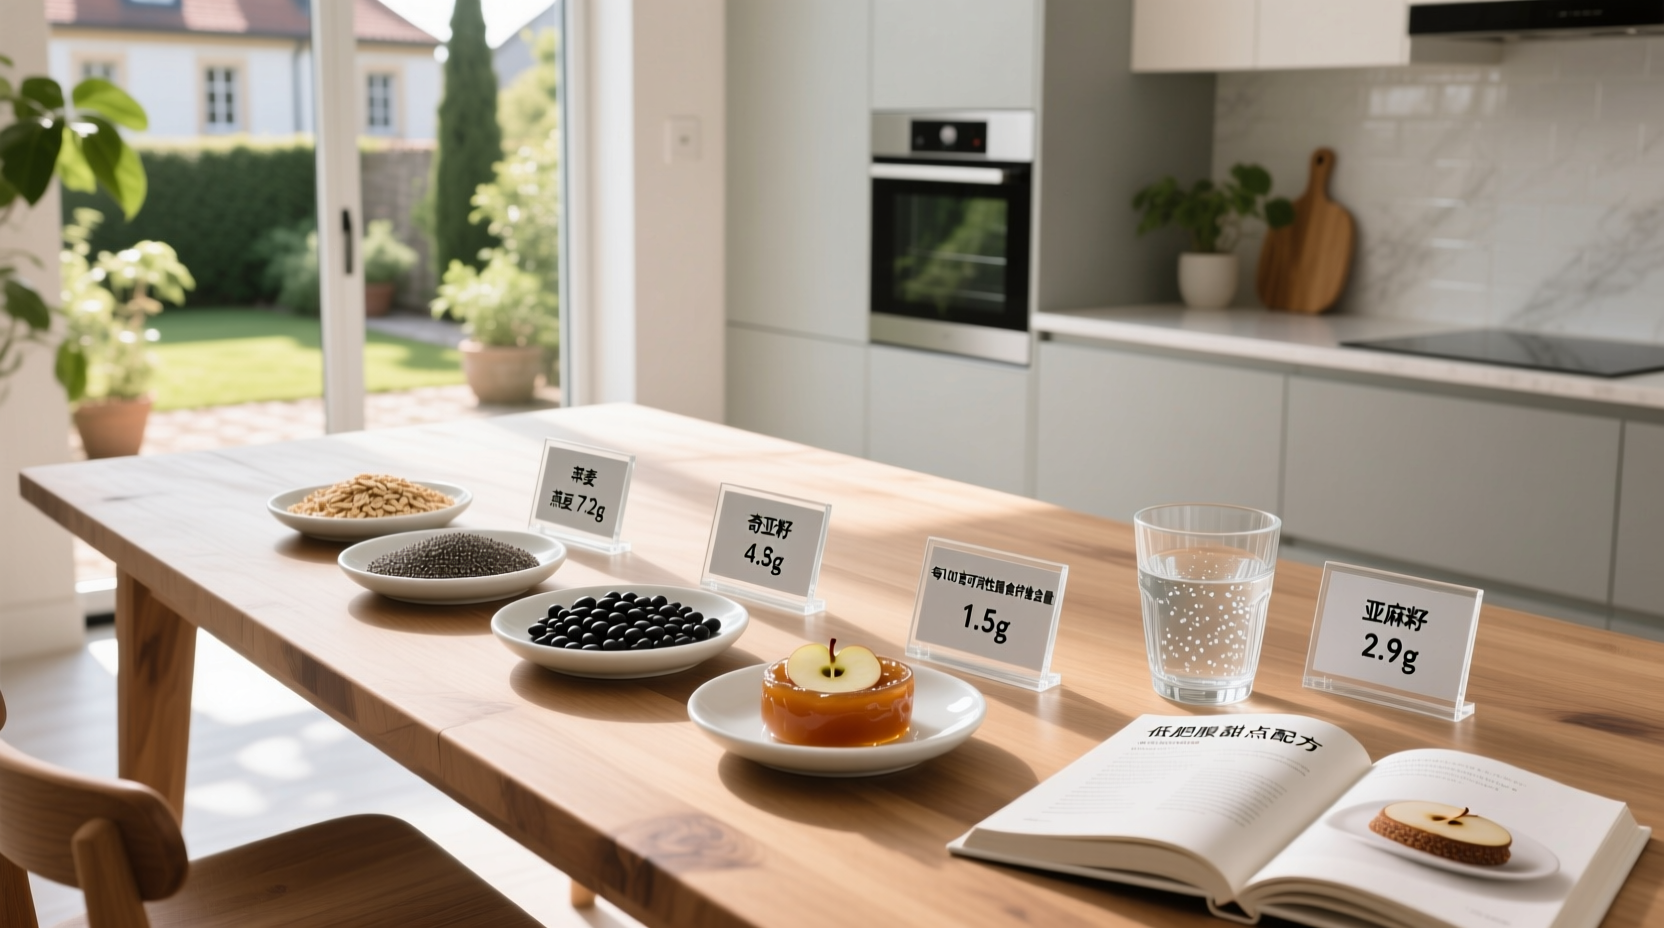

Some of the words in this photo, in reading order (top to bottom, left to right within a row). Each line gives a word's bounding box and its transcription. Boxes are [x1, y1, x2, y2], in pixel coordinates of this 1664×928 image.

[576, 494, 606, 523] 7.2g
[747, 512, 794, 540] 奇亚籽
[963, 603, 1011, 645] 1.5g
[1361, 598, 1429, 632] 亚麻籽
[1361, 632, 1419, 675] 2.9g
